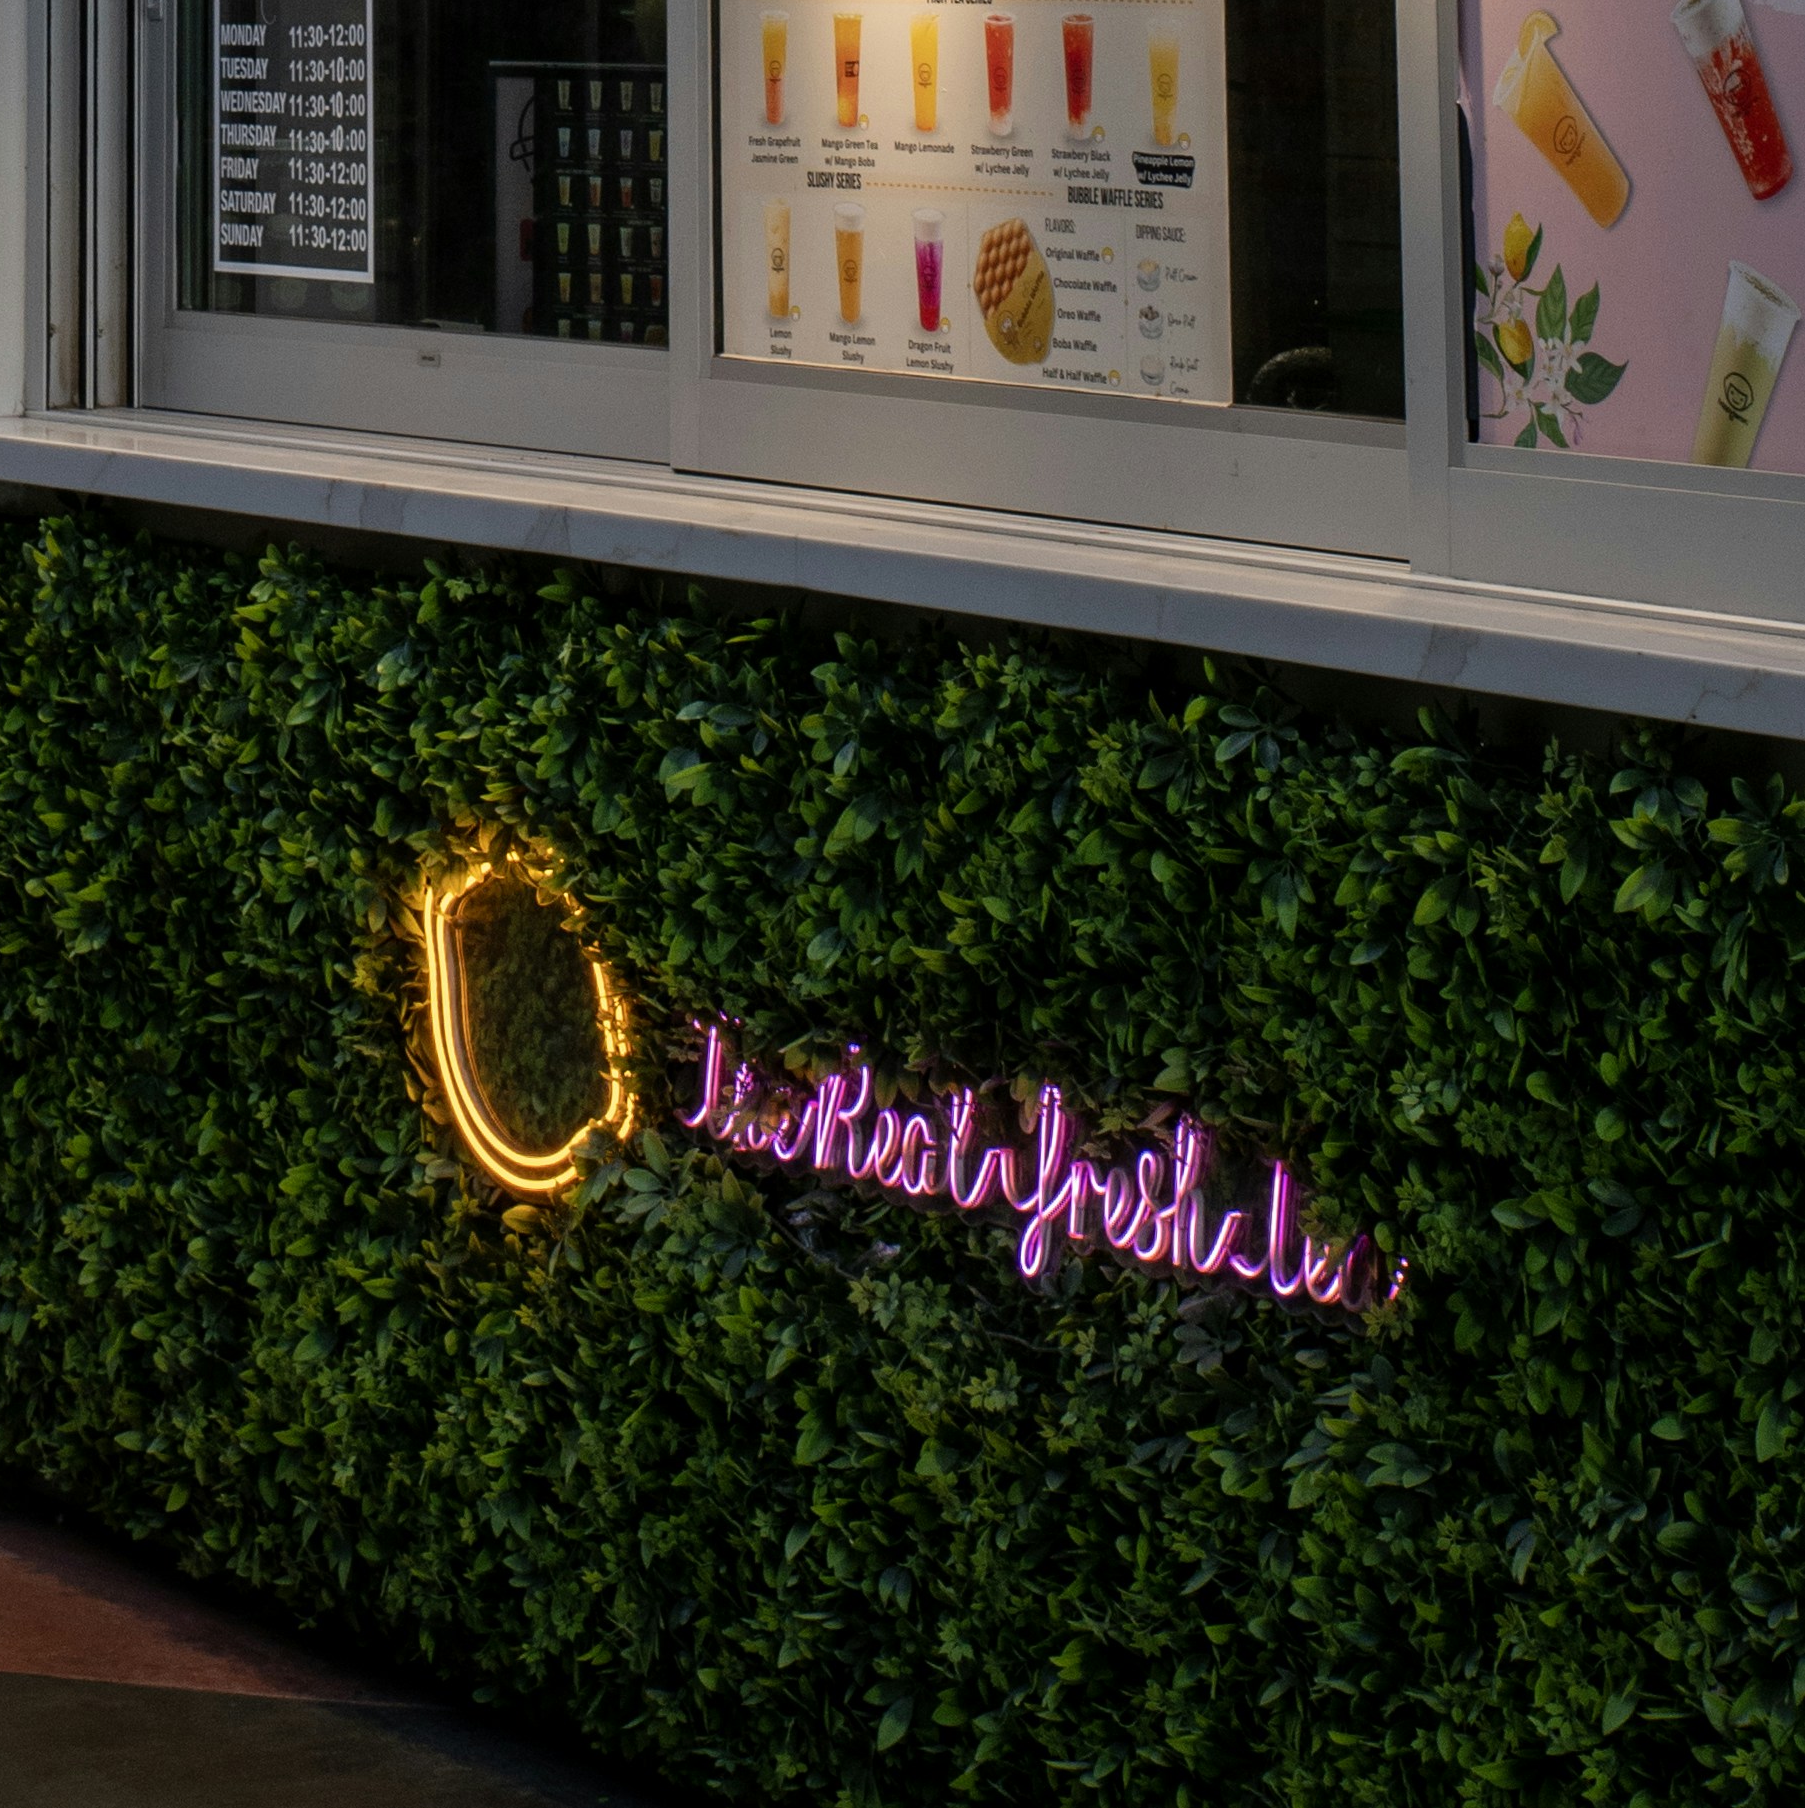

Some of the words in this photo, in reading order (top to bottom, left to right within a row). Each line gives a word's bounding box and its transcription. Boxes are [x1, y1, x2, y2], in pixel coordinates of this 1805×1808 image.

[221, 24, 266, 46] MONDAY
[289, 24, 364, 48] 11:30-12:00
[221, 58, 268, 79] TUESDAY
[289, 57, 364, 82] 11:30-10:00
[221, 90, 286, 113] WEDNESDAY
[289, 90, 365, 117] 11:30-10:00
[221, 124, 277, 146] THURSDAY
[289, 125, 365, 153] 11:30-10:00
[221, 157, 259, 179] FRIDAY
[289, 157, 365, 185] 11:30-12:00
[807, 171, 834, 188] SLUSHY
[836, 173, 861, 189] SERIES
[221, 190, 275, 214] SATURDAY
[289, 192, 366, 220] 11:30-12:00
[1068, 186, 1099, 204] BUBBLE
[1101, 189, 1133, 207] WAFFLE
[1135, 191, 1163, 209] SERIES
[221, 223, 264, 248] SUNDAY
[289, 224, 367, 251] 11:30-12:00
[1136, 224, 1162, 240] DIPPING
[1046, 248, 1075, 261] Original
[1076, 250, 1100, 262] Waffle
[1057, 309, 1072, 319] Oreo
[1074, 311, 1101, 322] Waffle
[908, 339, 933, 352] Dragon
[934, 343, 951, 353] Fruit
[906, 358, 929, 368] Lemon
[931, 360, 954, 373] Slushy
